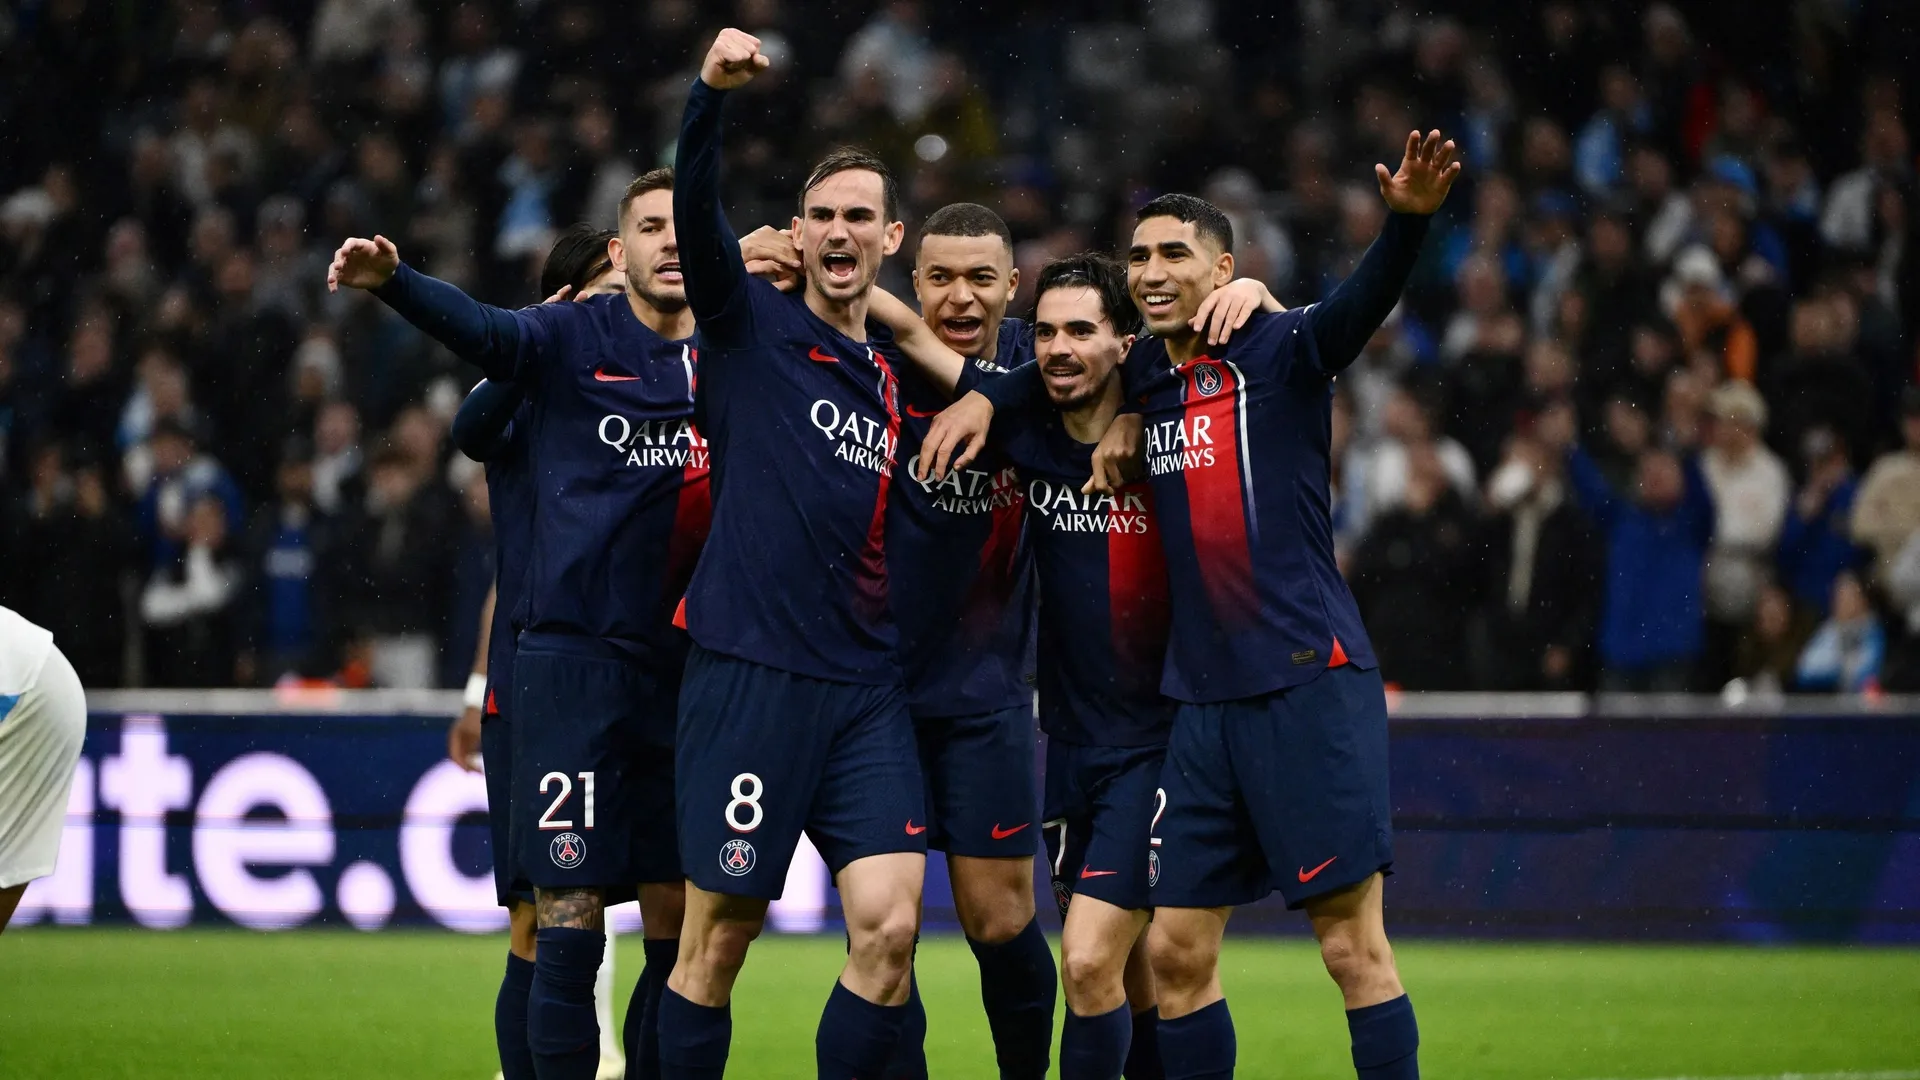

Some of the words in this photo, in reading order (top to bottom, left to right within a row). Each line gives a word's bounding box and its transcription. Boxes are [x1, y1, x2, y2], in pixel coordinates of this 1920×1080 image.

[810, 399, 898, 462] QATAR
[626, 448, 711, 469] AIRWAY
[1150, 447, 1215, 477] AIRWAYS
[1052, 512, 1148, 534] AIRWAYS
[538, 771, 595, 830] 21
[724, 772, 764, 833] 8
[555, 834, 579, 844] PARIS
[726, 841, 751, 851] PARIS
